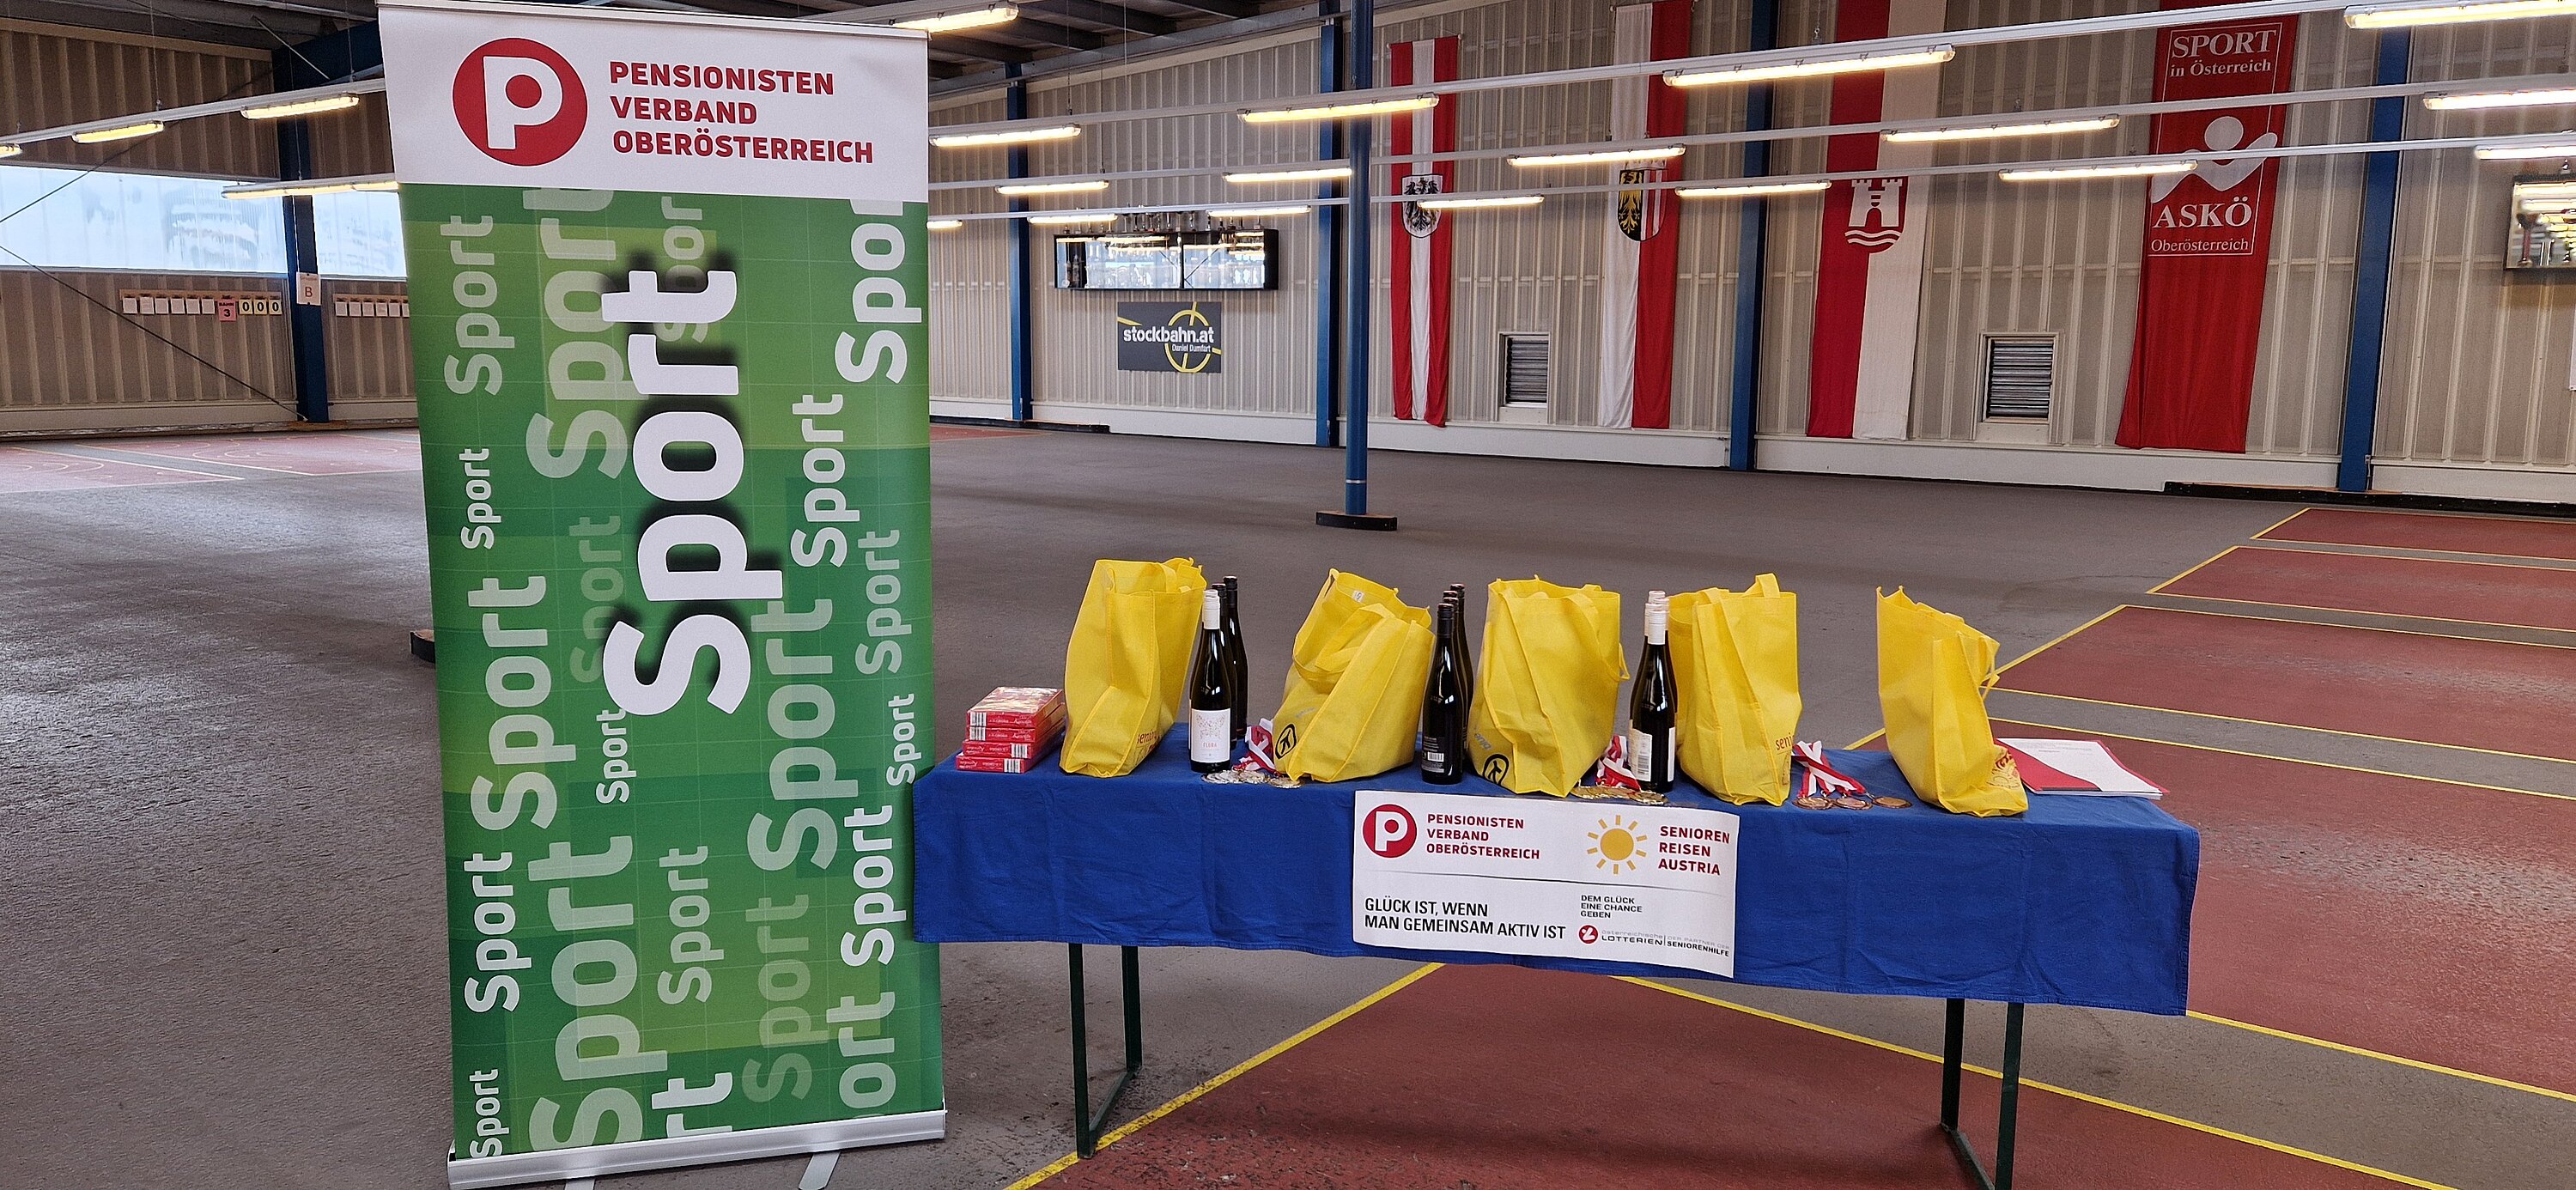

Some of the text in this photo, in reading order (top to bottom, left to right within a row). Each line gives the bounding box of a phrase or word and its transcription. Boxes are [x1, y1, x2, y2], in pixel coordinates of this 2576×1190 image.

[2172, 30, 2277, 58] SPORT
[610, 61, 835, 95] PENSIONISTEN
[2170, 59, 2271, 77] in Österreich
[610, 96, 757, 124] VERBAND
[612, 129, 873, 164] OBERÖSTERREICH
[2152, 197, 2251, 228] ASKÖ
[2151, 238, 2249, 252] Oberösterreich
[305, 286, 313, 297] B
[440, 215, 515, 396] Sport
[223, 308, 231, 317] 3
[1123, 326, 1214, 343] stockbahn.at
[601, 270, 783, 714] Sport
[790, 394, 860, 568] Sport
[459, 447, 501, 549] Sport
[855, 529, 912, 674] Sport
[468, 576, 576, 830] Sport
[747, 598, 859, 871] Sport
[886, 693, 922, 786] Sport
[595, 708, 637, 804] Sport
[1426, 829, 1489, 841] VERBAND
[1427, 814, 1524, 829] PENSIONISTEN
[1660, 826, 1730, 844] SENIOREN
[1426, 842, 1540, 859] OBERÖSTERREICH
[1659, 842, 1711, 857] REISEN
[1658, 859, 1721, 876] AUSTRIA
[841, 804, 907, 967] Sport
[1604, 895, 1635, 904] GLÜCK
[1365, 896, 1488, 917] GLÜCK IST, WENN
[1581, 902, 1643, 913] EINE CHANCE
[464, 852, 532, 1012] Sport
[657, 846, 724, 1005] Sport
[1365, 915, 1566, 939] MAN GEMEINSAM AKTIV IST
[1601, 930, 1663, 939] österreichische
[1601, 936, 1663, 945] LOTTERIEN
[1667, 941, 1730, 956] SENIORENHILFE
[528, 835, 668, 1151] Sport
[742, 894, 830, 1103] Sport
[469, 1069, 509, 1158] Sport
